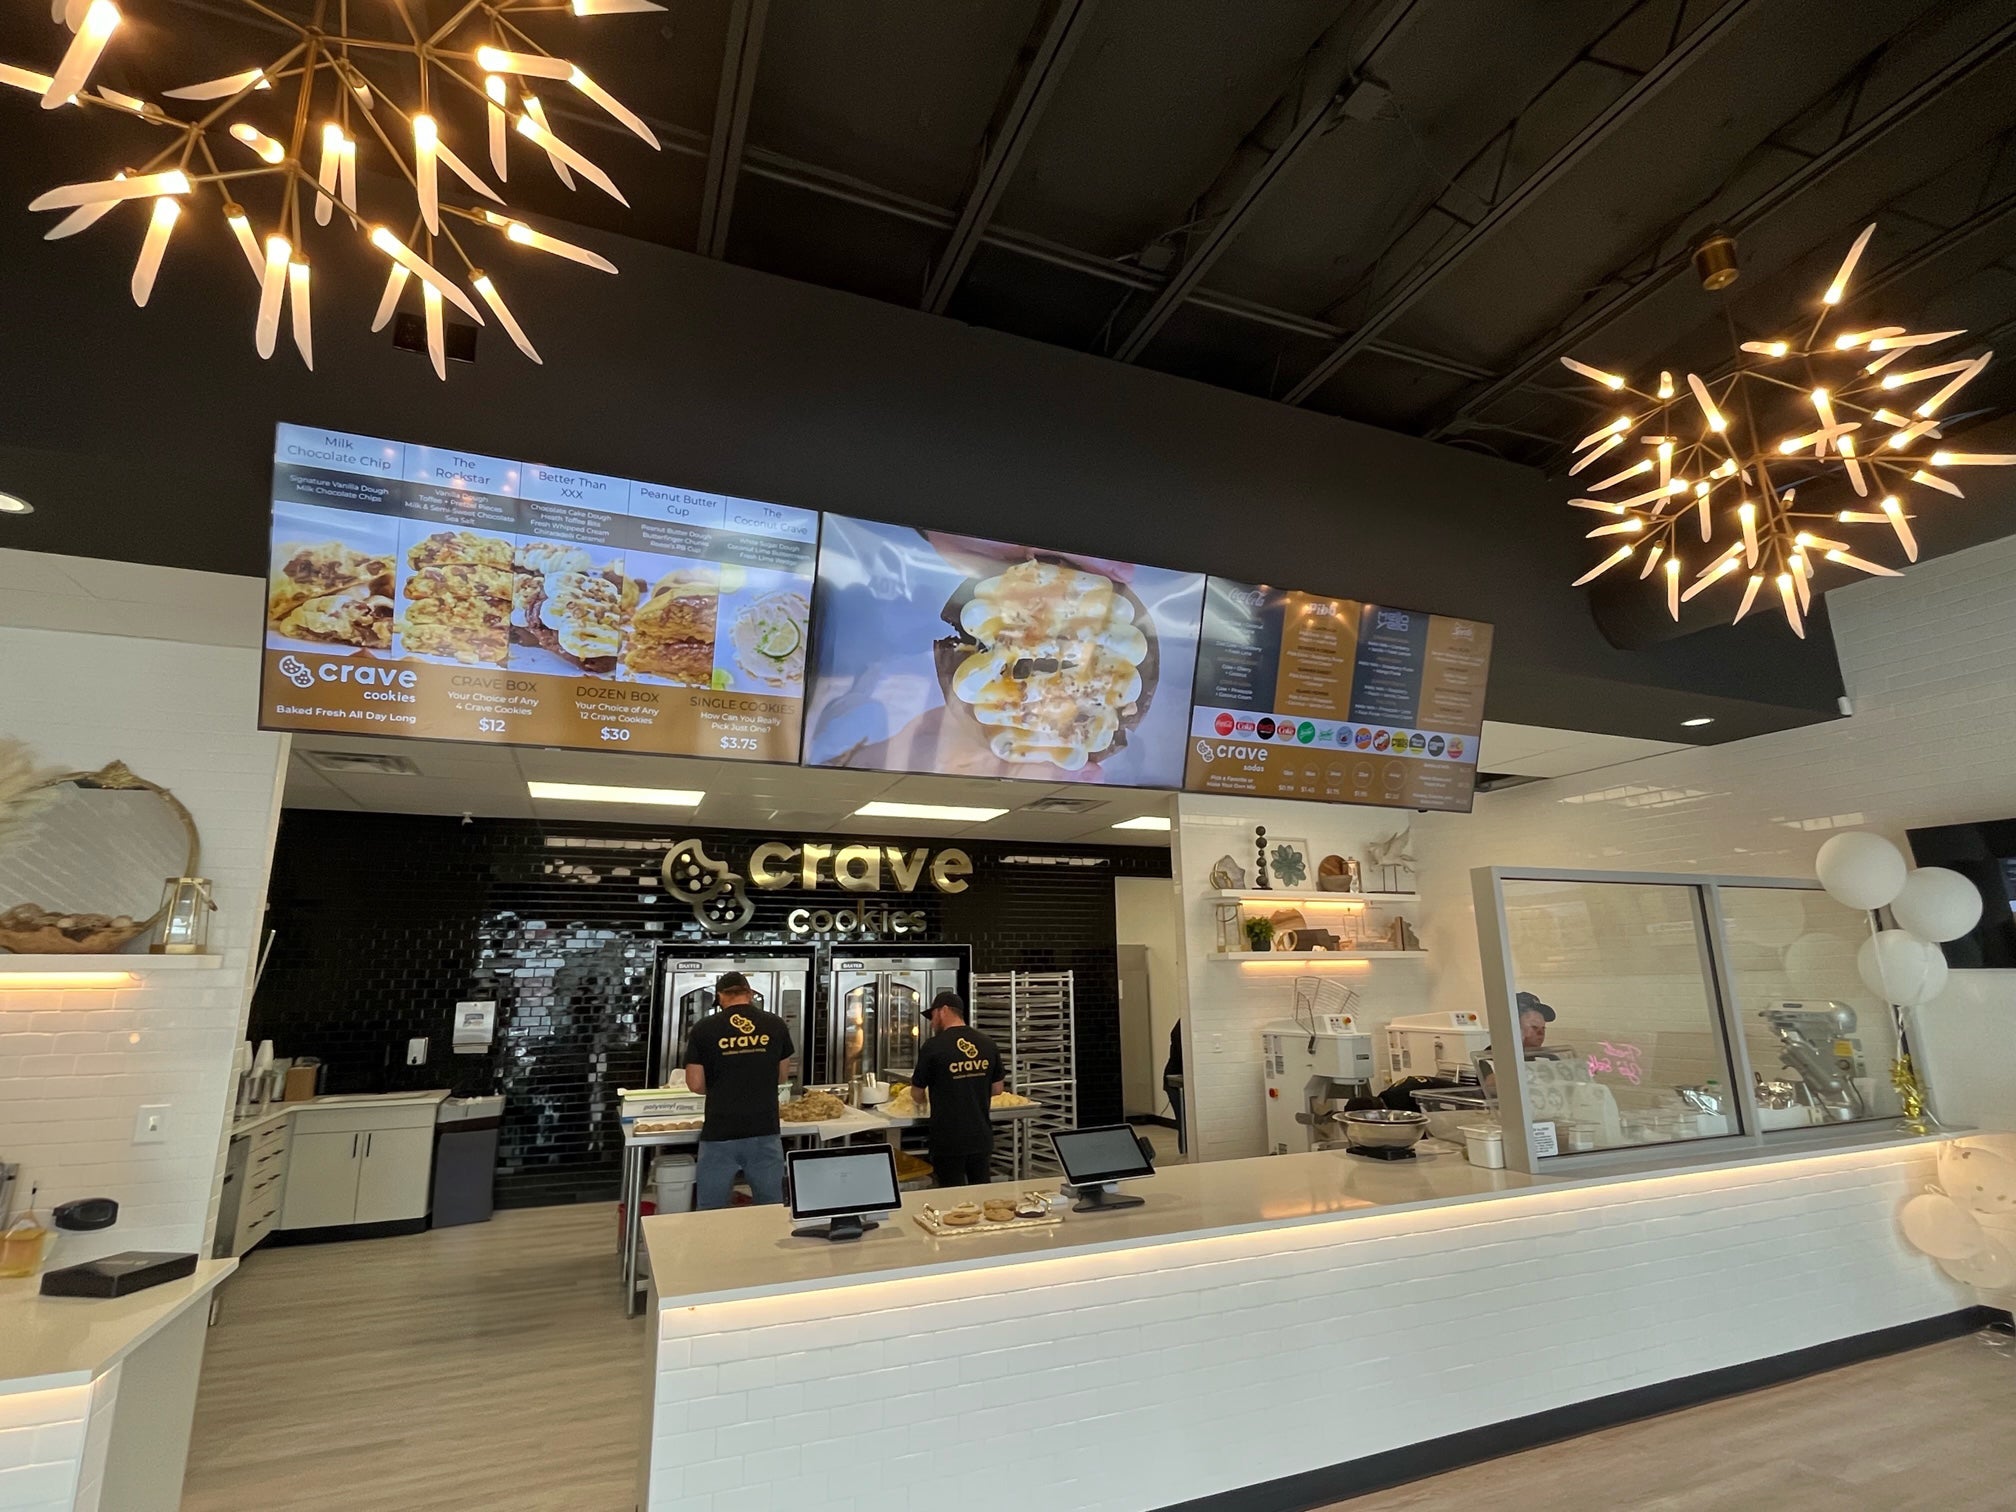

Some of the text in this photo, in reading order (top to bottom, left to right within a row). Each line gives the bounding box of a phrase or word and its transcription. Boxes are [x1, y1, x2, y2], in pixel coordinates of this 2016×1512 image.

[325, 437, 354, 449] Milk
[287, 445, 391, 470] Chocolate Chip
[453, 457, 475, 468] The
[436, 468, 490, 484] Rockstar
[539, 471, 606, 490] Better Than
[290, 475, 389, 495] Signature Vanilla Dough
[316, 487, 357, 498] Chocolate
[359, 493, 382, 502] Chips
[561, 488, 583, 499] XXX
[641, 488, 718, 508] Peanut Butter
[419, 495, 442, 503] Toffee
[450, 499, 477, 508] Pretzel
[405, 501, 420, 509] Milk
[477, 512, 515, 522] Chocolate
[531, 504, 611, 521] Chocolate Cake Dough
[667, 505, 689, 517] Cup
[763, 508, 782, 518] The
[530, 519, 609, 536] Fresh Whipped Cream
[734, 516, 808, 535] Coconut Crave
[689, 531, 712, 540] Dough
[779, 544, 800, 552] Dough
[319, 663, 417, 688] crave
[451, 675, 537, 692] CRAVE BOX
[364, 690, 416, 703] cookies
[448, 691, 470, 700] Your
[472, 693, 506, 703] Choice
[520, 697, 539, 707] Any
[576, 687, 659, 703] DOZEN BOX
[465, 703, 493, 712] Crave
[494, 706, 532, 715] Cookies
[575, 701, 596, 709] Your
[598, 703, 629, 712] Choice
[641, 707, 659, 716] Any
[690, 696, 795, 714] SINGLE COOKIES
[277, 705, 416, 724] Baked Fresh All Day Long
[591, 713, 616, 721] Crave
[618, 715, 653, 724] Cookies
[721, 713, 738, 721] Can
[740, 715, 756, 723] You
[479, 717, 506, 732] $12
[712, 722, 771, 733] Pick Just One?
[601, 726, 630, 741] $30
[720, 736, 757, 750] $3.75
[1217, 744, 1268, 761] crave
[1244, 764, 1264, 772] sodas
[749, 841, 974, 894] crave
[787, 900, 928, 935] cookies
[718, 1034, 769, 1049] crave
[949, 1060, 989, 1073] crave
